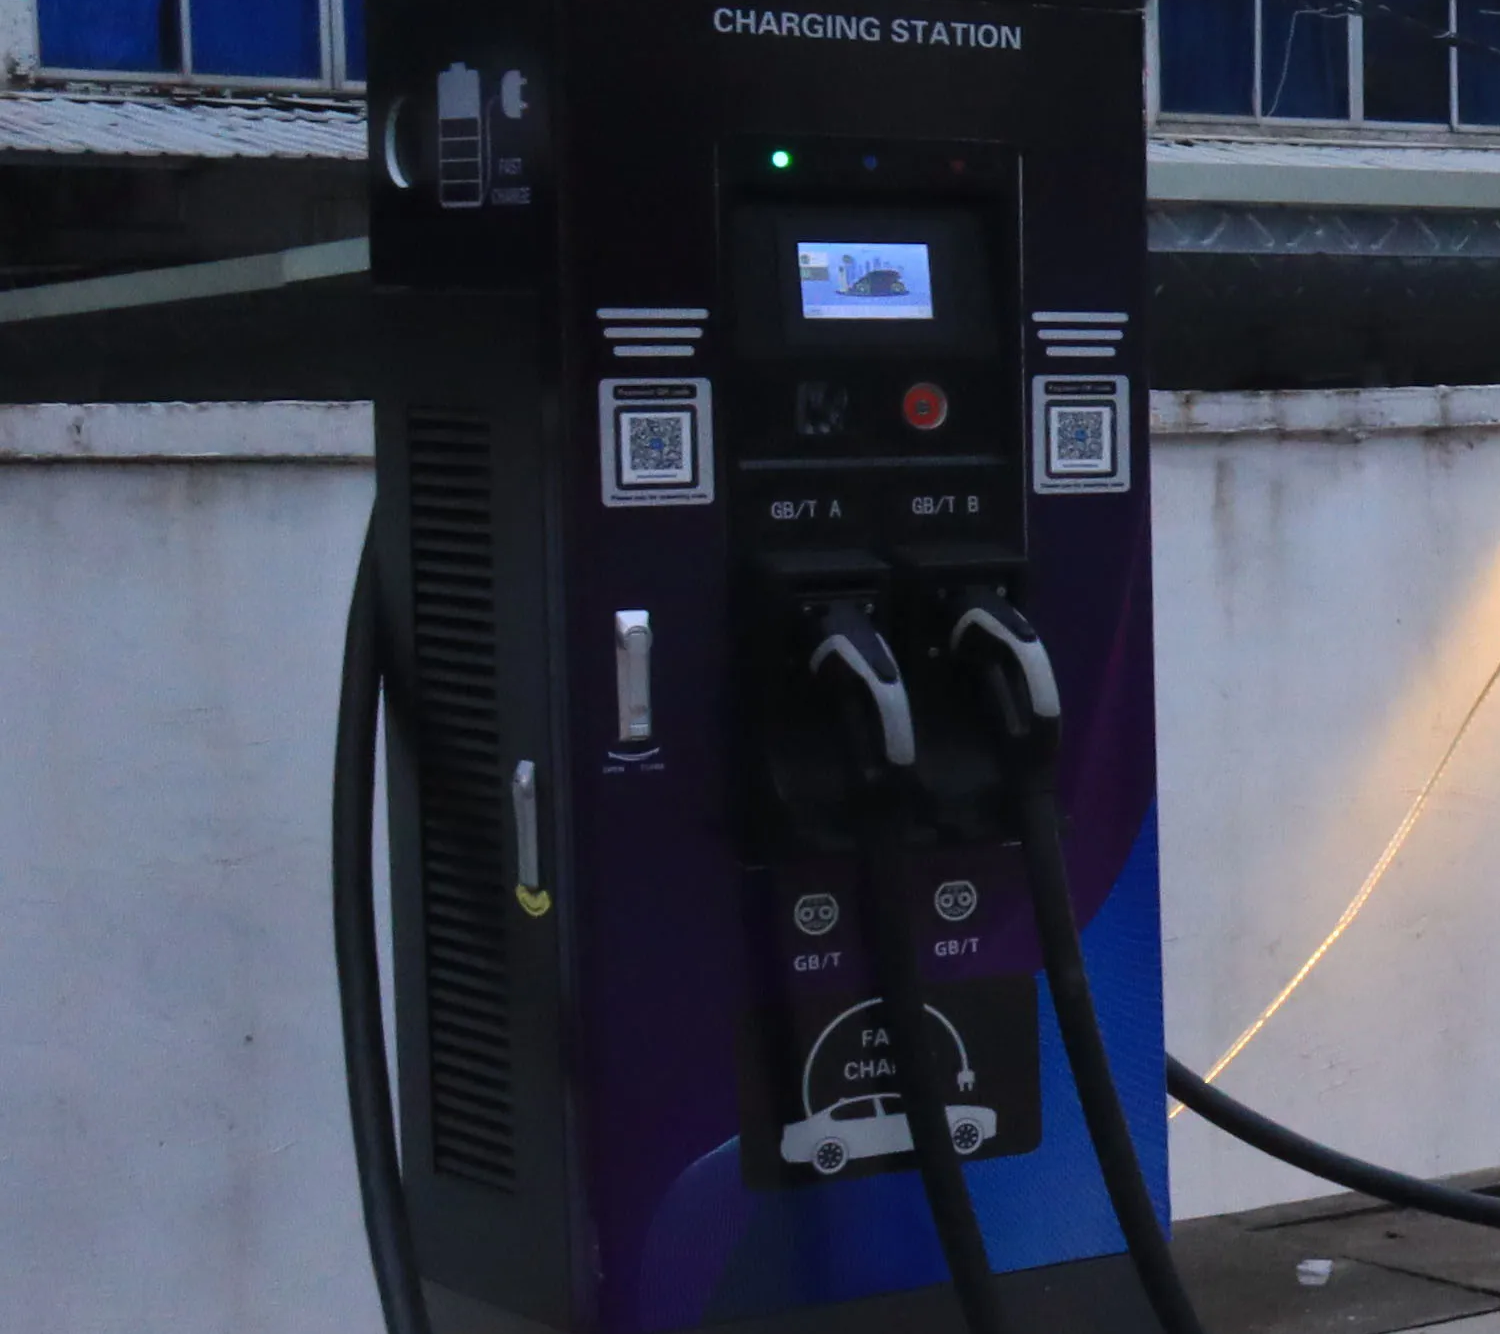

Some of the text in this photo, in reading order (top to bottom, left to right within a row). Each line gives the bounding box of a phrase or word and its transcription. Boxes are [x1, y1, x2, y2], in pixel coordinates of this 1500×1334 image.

[713, 7, 1023, 52] CHARGING STATION
[770, 499, 842, 520] GB/T A
[911, 495, 980, 516] GB/T B
[934, 937, 980, 957] GB/T
[793, 951, 842, 972] GB/T
[861, 1028, 890, 1050] FA
[843, 1058, 896, 1080] CHA
